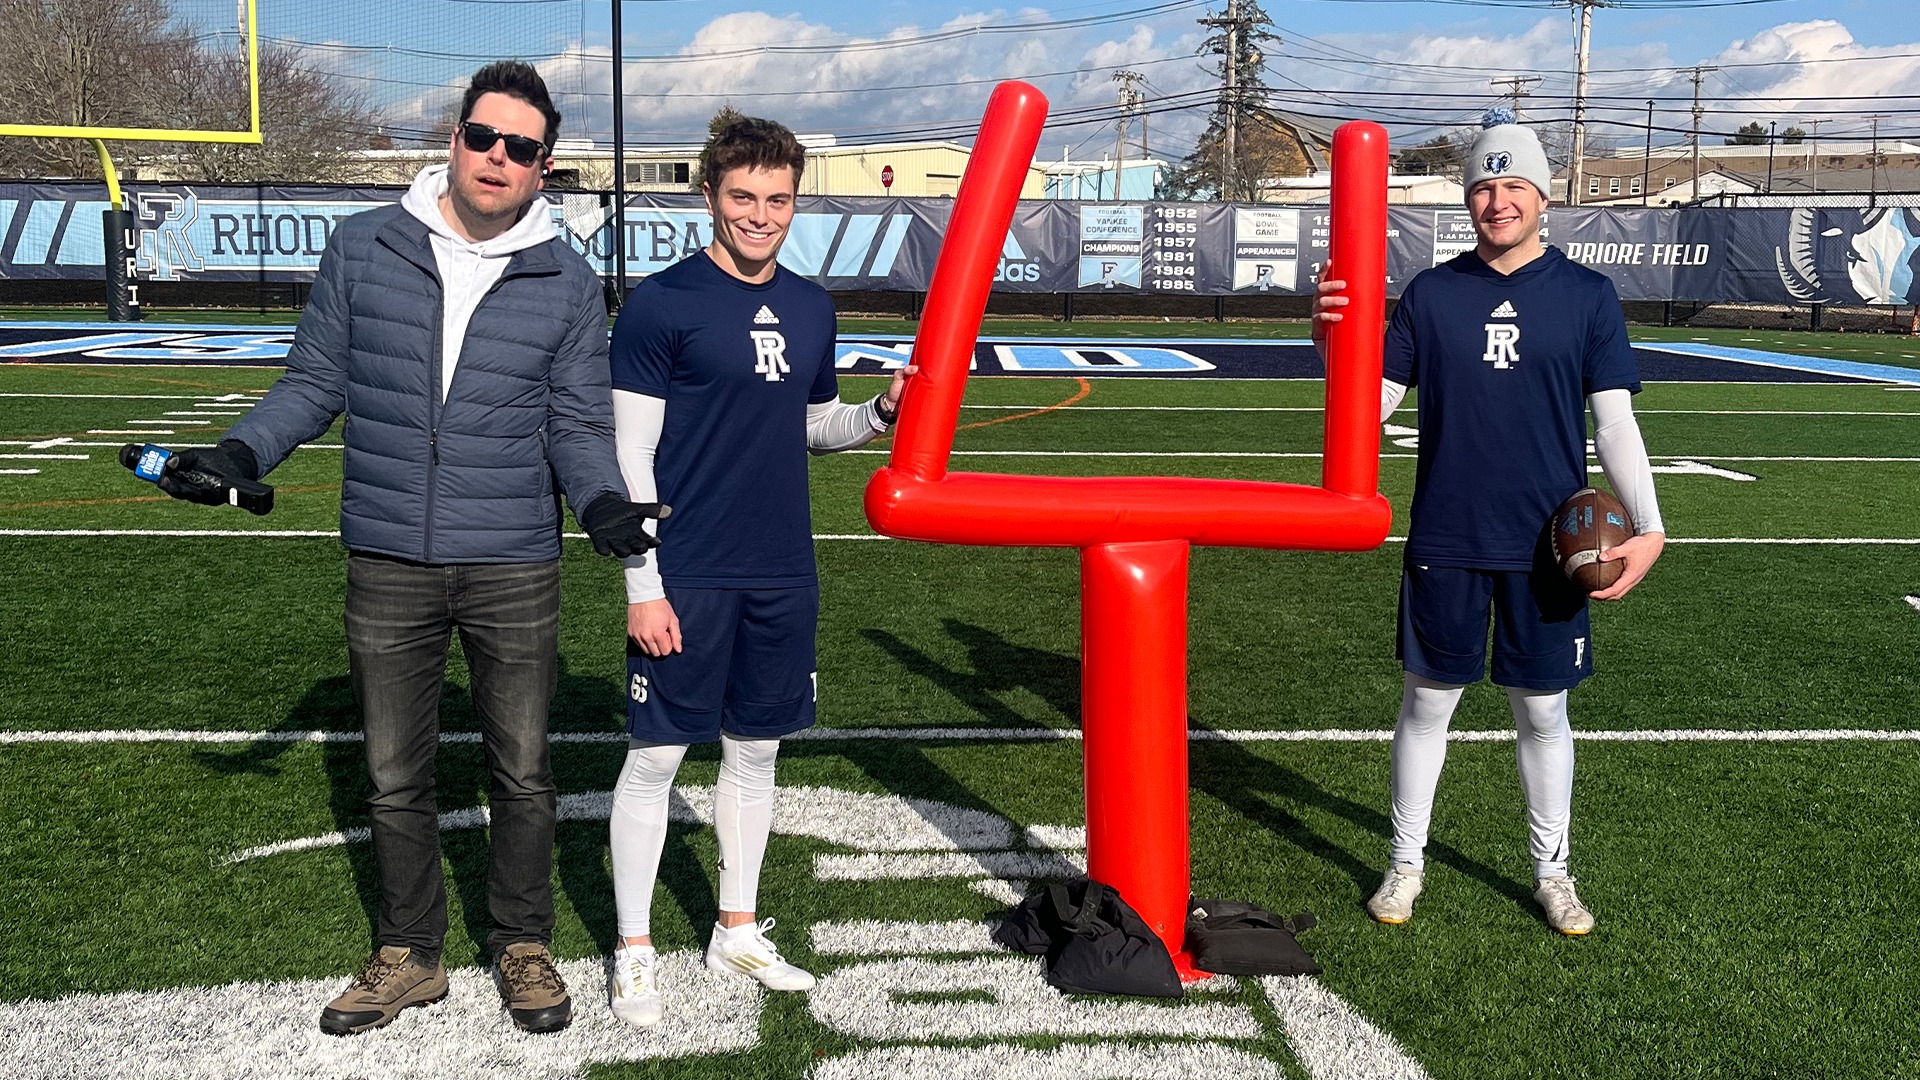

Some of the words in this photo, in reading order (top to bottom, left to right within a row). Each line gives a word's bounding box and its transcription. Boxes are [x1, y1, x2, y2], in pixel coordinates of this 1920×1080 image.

[1154, 207, 1197, 219] 1952
[1086, 226, 1138, 234] CONFERENCE
[1154, 222, 1197, 233] 1955
[211, 213, 350, 256] RHOD
[1153, 237, 1196, 247] 1957
[1083, 243, 1140, 253] CHAMPIONS
[1237, 247, 1297, 256] APPEARANCES
[1152, 251, 1195, 262] 1981
[1566, 242, 1646, 265] PRIORE
[1651, 243, 1710, 266] FIELD
[1152, 265, 1195, 276] 1984
[1152, 279, 1194, 290] 1985
